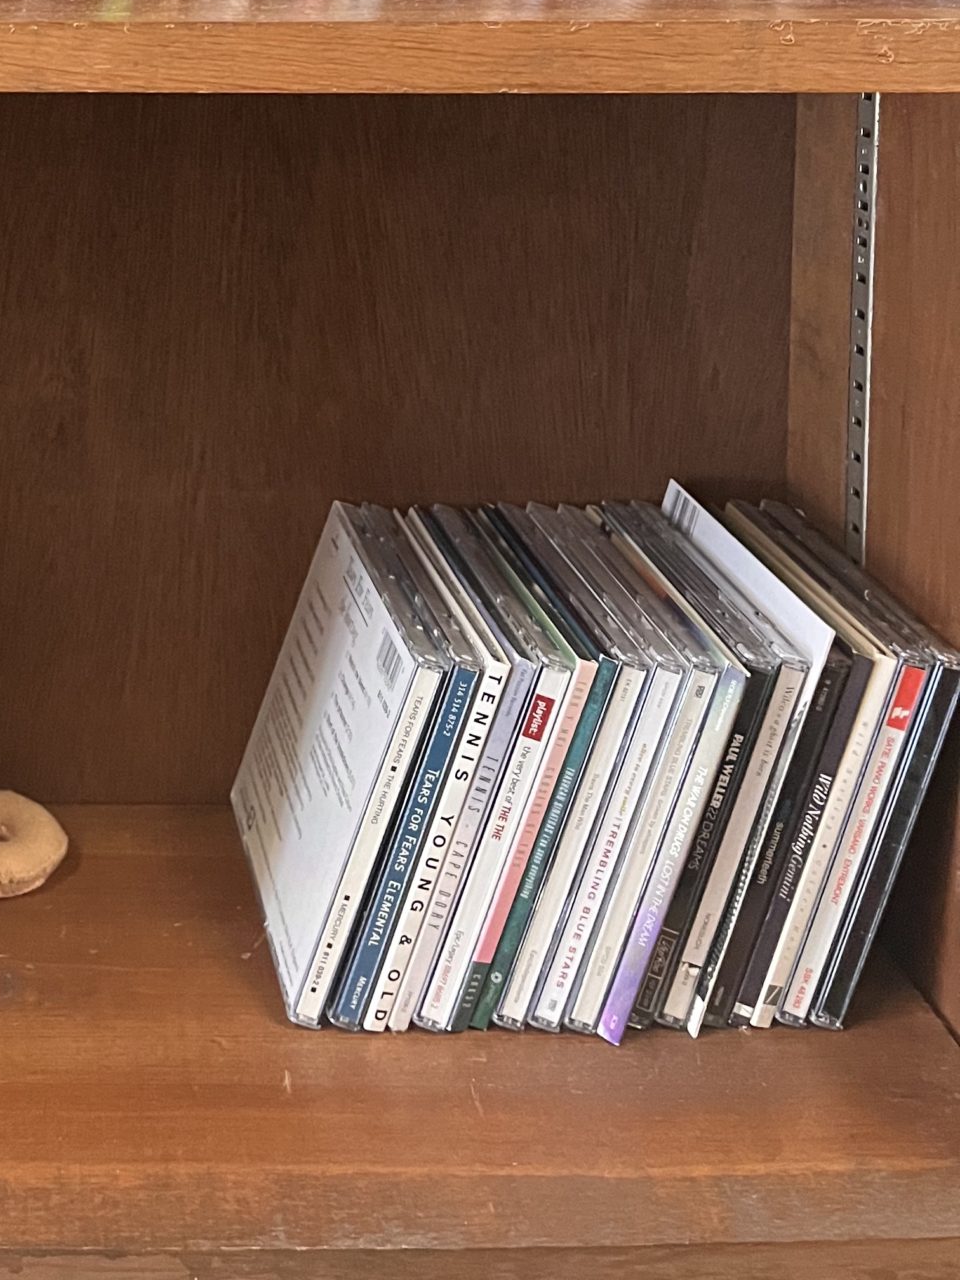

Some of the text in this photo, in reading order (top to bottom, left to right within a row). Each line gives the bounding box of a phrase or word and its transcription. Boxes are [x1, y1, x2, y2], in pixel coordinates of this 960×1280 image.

[521, 746, 532, 759] the
[726, 734, 744, 761] PAUL
[512, 760, 527, 777] very
[507, 778, 518, 794] best
[710, 764, 733, 808] WELLER
[504, 795, 513, 804] of
[498, 805, 512, 822] THE
[705, 808, 719, 819] 22
[313, 695, 424, 985] TEARS FOR FEARS THE HURTING MERCURY 811 039-2
[492, 824, 505, 841] THE
[375, 674, 502, 1021] TENNIS YOUNG & OLD
[638, 766, 709, 946] THE WAR ON DRUGS LOST IN THE DREAM
[688, 821, 715, 870] DREAMS
[757, 822, 784, 884] summerteeth
